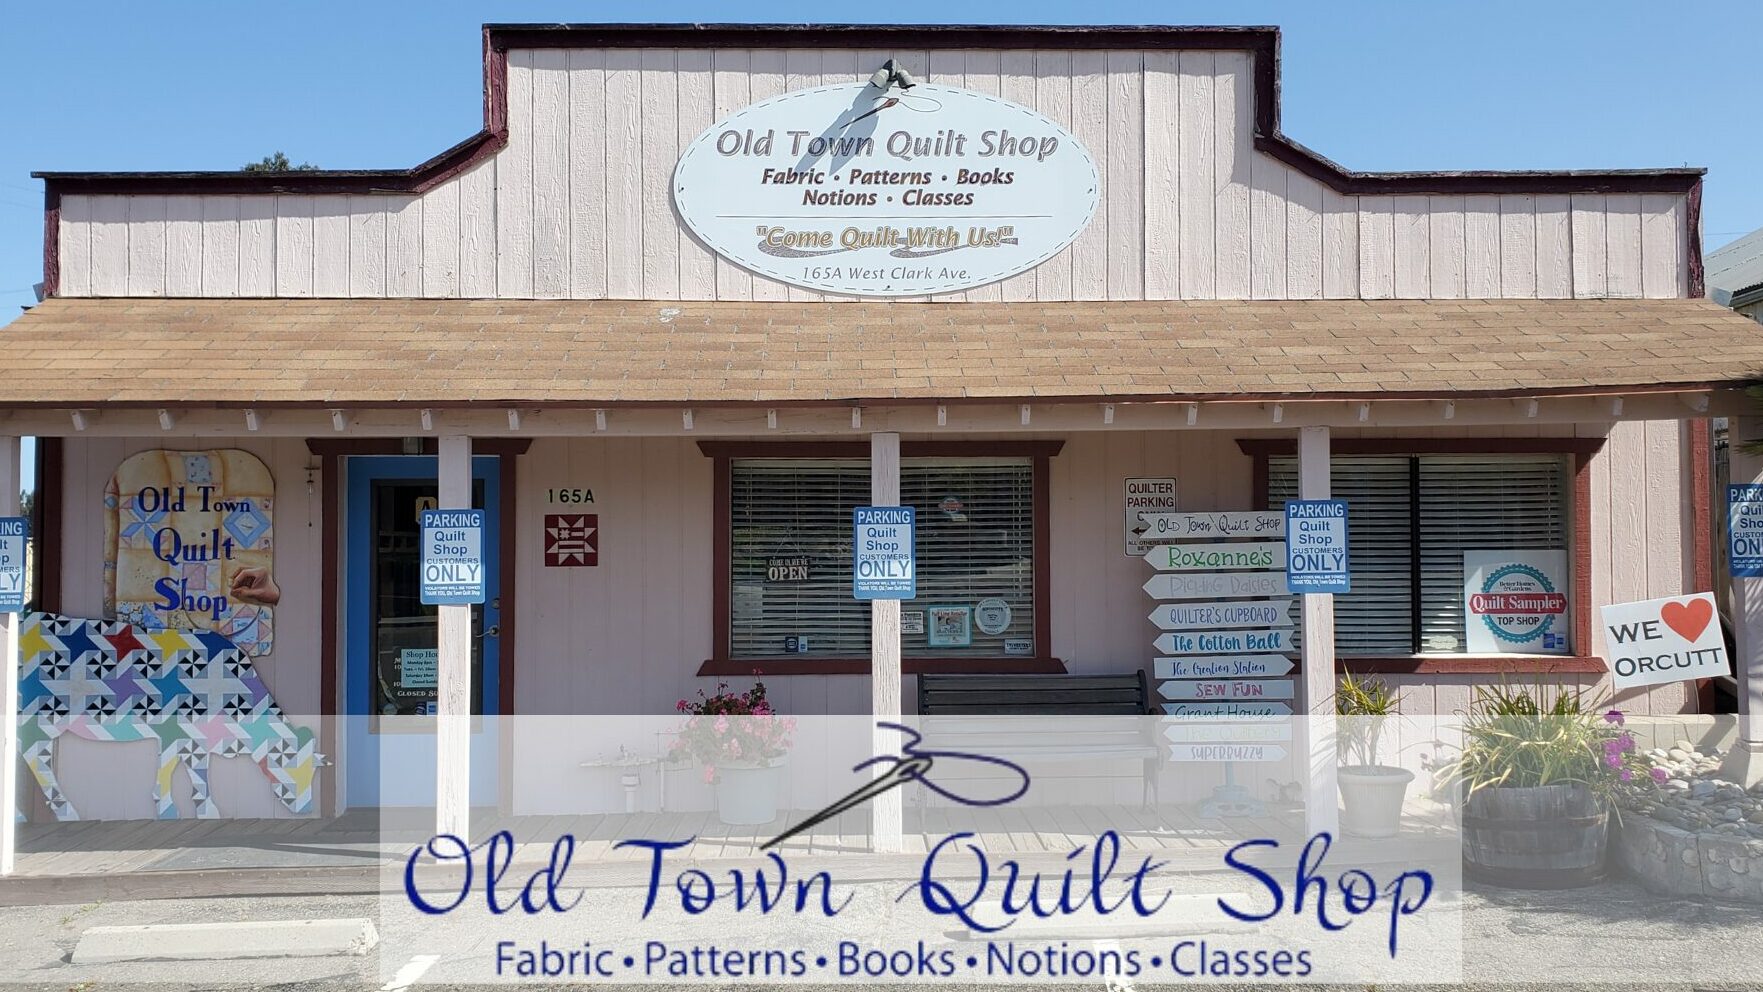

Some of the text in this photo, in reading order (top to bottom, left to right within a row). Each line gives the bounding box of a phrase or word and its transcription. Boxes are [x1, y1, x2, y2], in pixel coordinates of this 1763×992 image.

[716, 129, 1059, 162] Old Town Quilt Shop
[761, 167, 1014, 185] Fabric Patterns Books
[802, 188, 974, 206] Notions Classes
[756, 225, 1015, 251] "Come Quilt With Us!"
[803, 266, 971, 280] 165A West Clark Ave.
[549, 488, 594, 503] 165A
[1128, 483, 1173, 494] QUILTER
[1730, 488, 1763, 502] PARK
[138, 486, 251, 513] Old Town
[1127, 497, 1174, 508] PARKING
[857, 511, 911, 524] PARKING
[1290, 504, 1344, 518] PARKING
[1740, 505, 1763, 515] Qui
[425, 514, 480, 527] PARKING
[1184, 516, 1212, 534] Town
[1299, 520, 1330, 532] Quilt
[1740, 518, 1763, 528] Sho
[434, 530, 466, 542] Quilt
[867, 527, 896, 538] Quilt
[1298, 534, 1332, 546] Shop
[152, 527, 235, 566] Quilt
[433, 544, 467, 556] Shop
[866, 540, 898, 552] Shop
[1168, 546, 1273, 568] Roxanne's
[1292, 554, 1344, 571] ONLY
[426, 564, 480, 582] ONLY
[768, 566, 808, 581] OPEN
[859, 560, 910, 577] ONLY
[153, 577, 228, 622] Shop
[1473, 595, 1563, 612] Quilt Sampler
[1170, 606, 1277, 624] QUILTER'S CUPBOARD
[1497, 616, 1539, 625] TOP SHOP
[1608, 620, 1663, 644] WE
[1172, 632, 1281, 651] The Cotton Ball
[406, 651, 424, 659] Shop
[1615, 647, 1722, 677] ORCUTT
[1172, 661, 1265, 676] The Creation Station
[1195, 682, 1263, 698] SEW FUN
